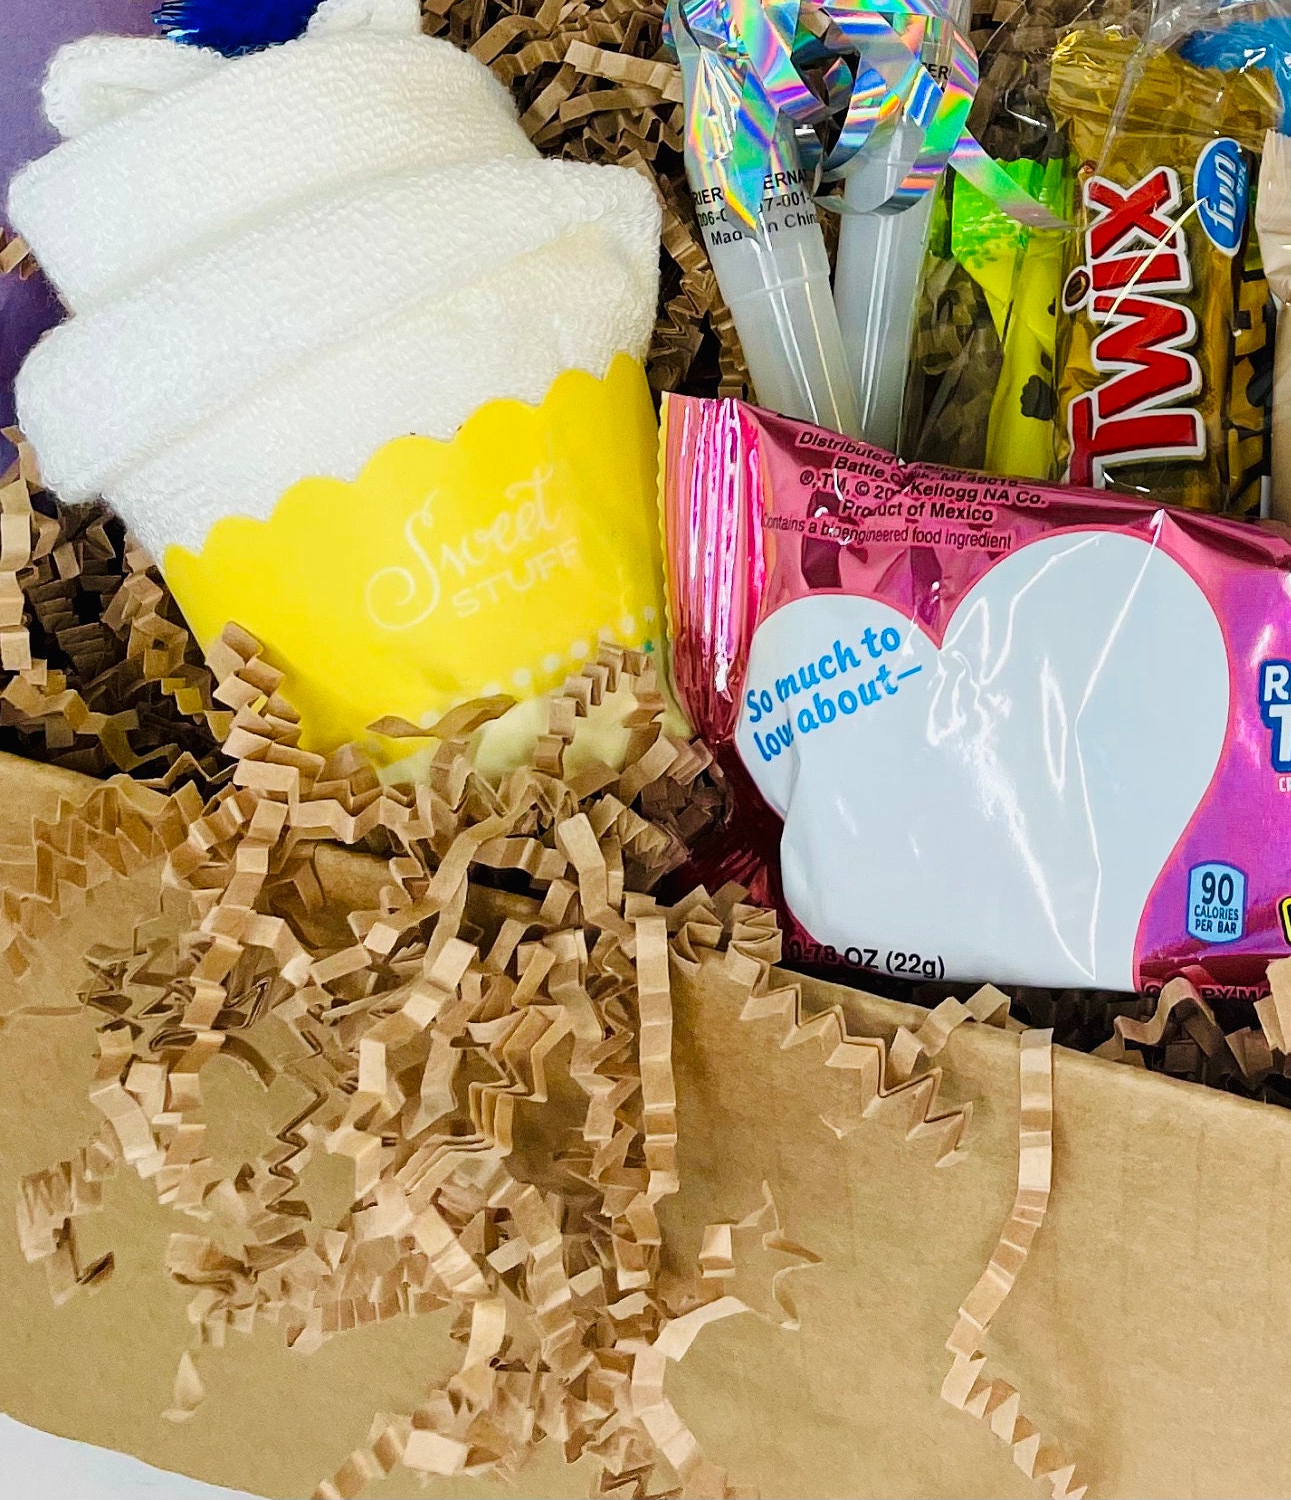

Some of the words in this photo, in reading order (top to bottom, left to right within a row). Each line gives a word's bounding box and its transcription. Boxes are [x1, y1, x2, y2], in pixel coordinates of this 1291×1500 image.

[1201, 152, 1236, 233] fun
[785, 212, 816, 228] Chin
[799, 431, 895, 465] Distributed
[834, 455, 886, 479] Battle
[910, 481, 978, 503] Kellogg
[982, 487, 1010, 502] NA
[1015, 490, 1046, 506] Co.
[906, 501, 926, 517] of
[930, 502, 994, 522] Mexico
[365, 463, 562, 631] Sweet
[761, 512, 805, 532] Contains
[808, 523, 818, 534] a
[912, 525, 942, 544] food
[945, 528, 1012, 550] ingredient
[452, 536, 579, 619] STUFF
[746, 689, 773, 723] So
[775, 639, 862, 703] much
[861, 627, 901, 659] to
[753, 717, 795, 763] lov
[1200, 871, 1234, 906] 90
[1194, 904, 1239, 921] CALORIES
[1194, 919, 1213, 933] PER
[1217, 920, 1237, 935] BAR
[844, 946, 879, 970] OZ
[885, 950, 945, 980] (22g)
